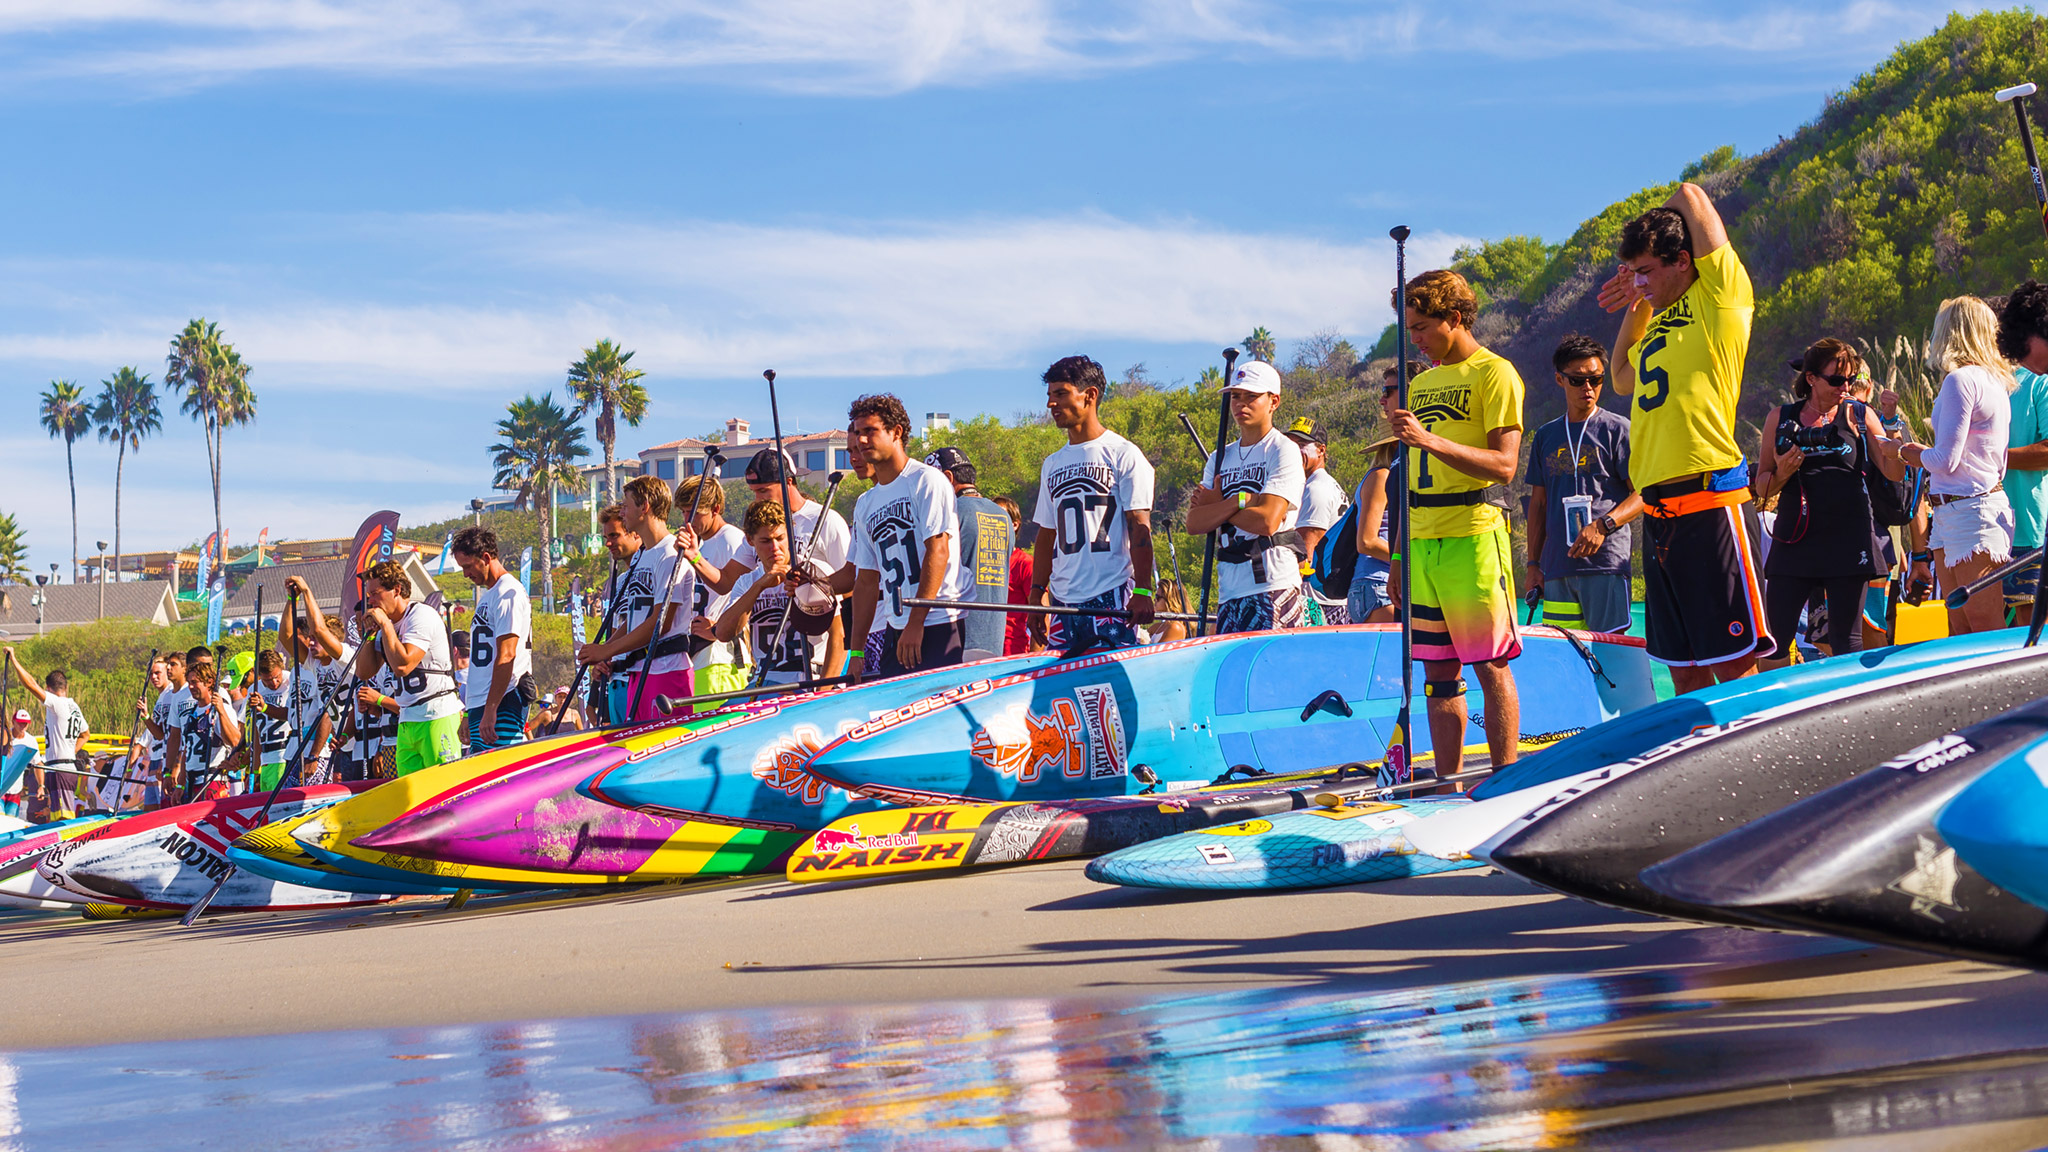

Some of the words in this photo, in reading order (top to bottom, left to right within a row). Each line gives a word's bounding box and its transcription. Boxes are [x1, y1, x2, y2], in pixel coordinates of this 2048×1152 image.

[1638, 335, 1669, 413] 5
[1438, 389, 1471, 415] PADDLE
[1078, 467, 1113, 490] PADDLE
[1057, 494, 1117, 555] 07
[878, 530, 921, 594] 51
[471, 626, 494, 668] 6
[1081, 688, 1101, 729] PADDLE
[1104, 687, 1121, 733] APPOVED
[1094, 736, 1116, 778] BATTLE
[63, 825, 113, 857] FANATIC
[792, 842, 965, 874] NAISH
[867, 836, 893, 848] Red
[894, 832, 918, 847] Bull
[1311, 837, 1381, 867] FOCUS
